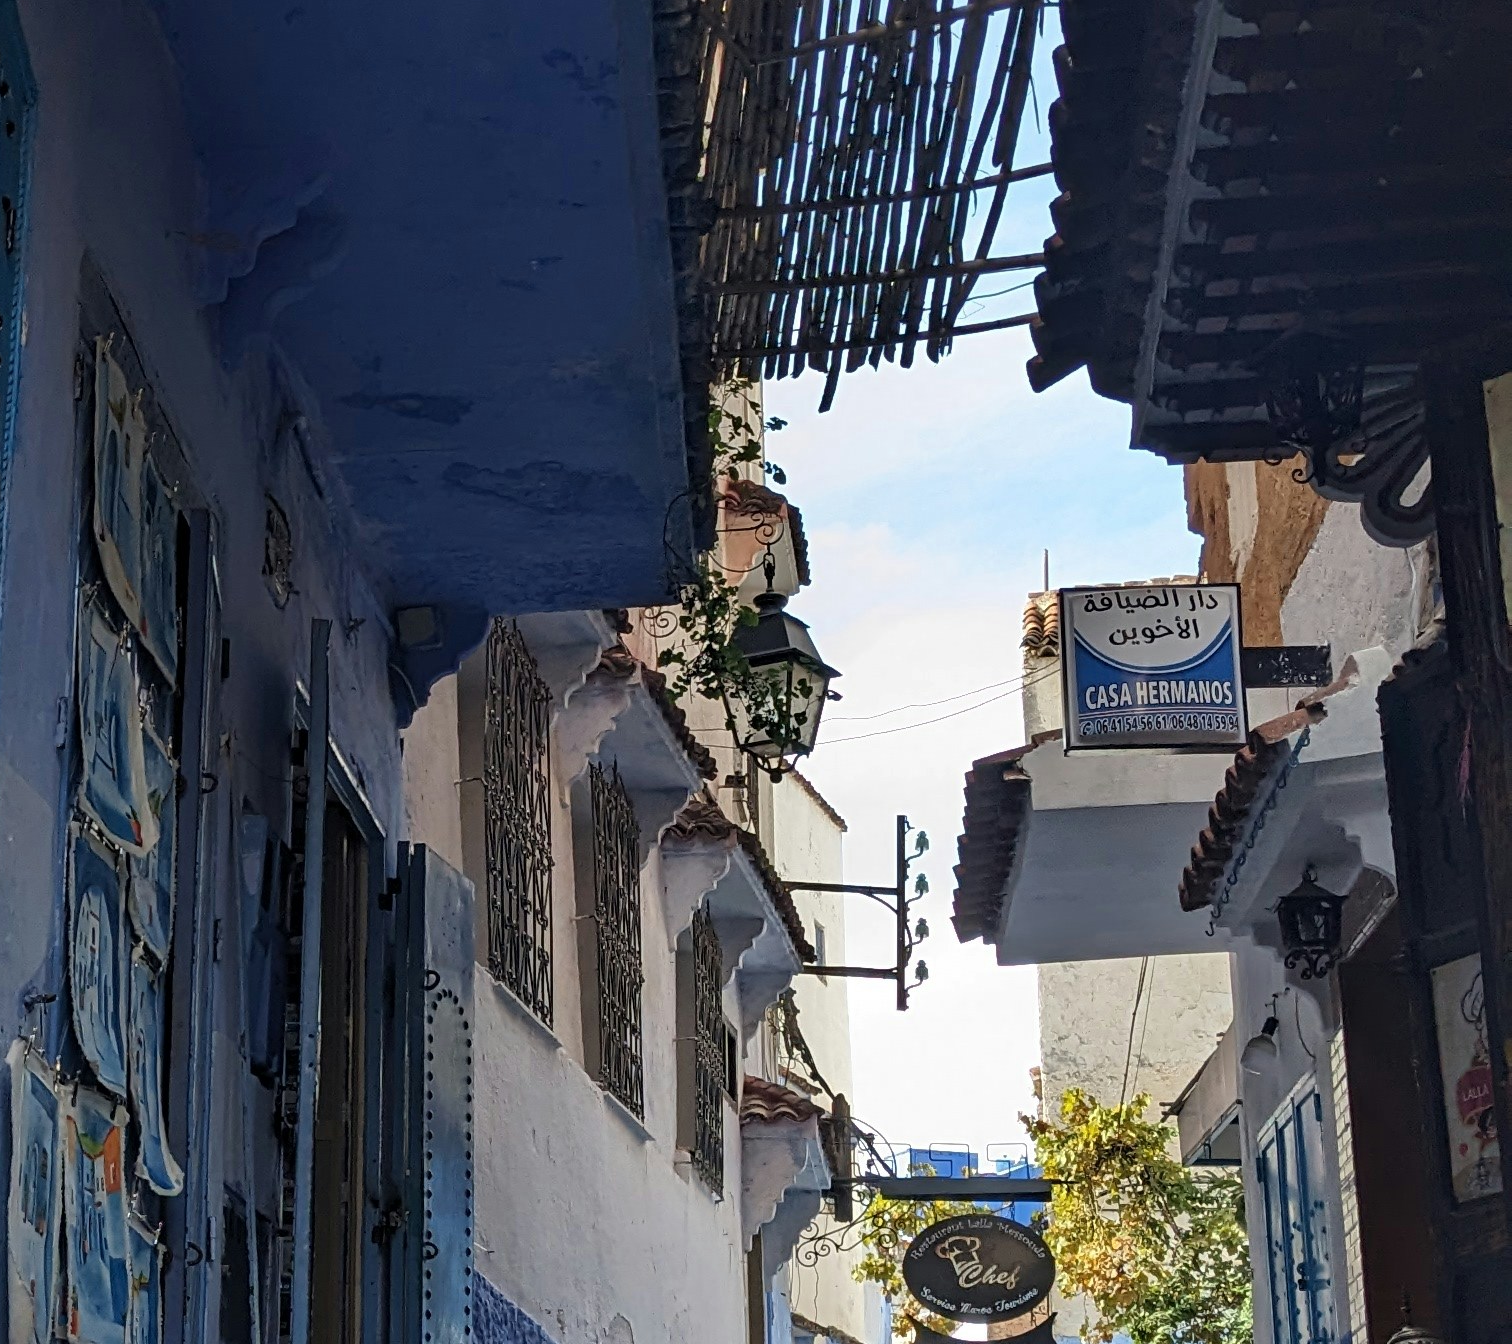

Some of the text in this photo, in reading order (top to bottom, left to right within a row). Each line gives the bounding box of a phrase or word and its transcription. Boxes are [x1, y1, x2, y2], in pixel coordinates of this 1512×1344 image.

[1083, 588, 1219, 614] دار الضيافة
[1108, 615, 1200, 646] الأخوين
[1085, 680, 1234, 710] CASA HERMANOS
[1096, 718, 1109, 735] 06
[1111, 717, 1122, 733] 41
[1125, 716, 1138, 732] 54
[1141, 715, 1154, 731] 56
[1187, 713, 1199, 730] 48
[1201, 714, 1213, 730] 14
[1215, 715, 1227, 731] 59
[967, 1218, 993, 1230] Lalla
[958, 1263, 1021, 1290] Chef
[920, 1286, 1039, 1315] Service Maroc Tourisme
